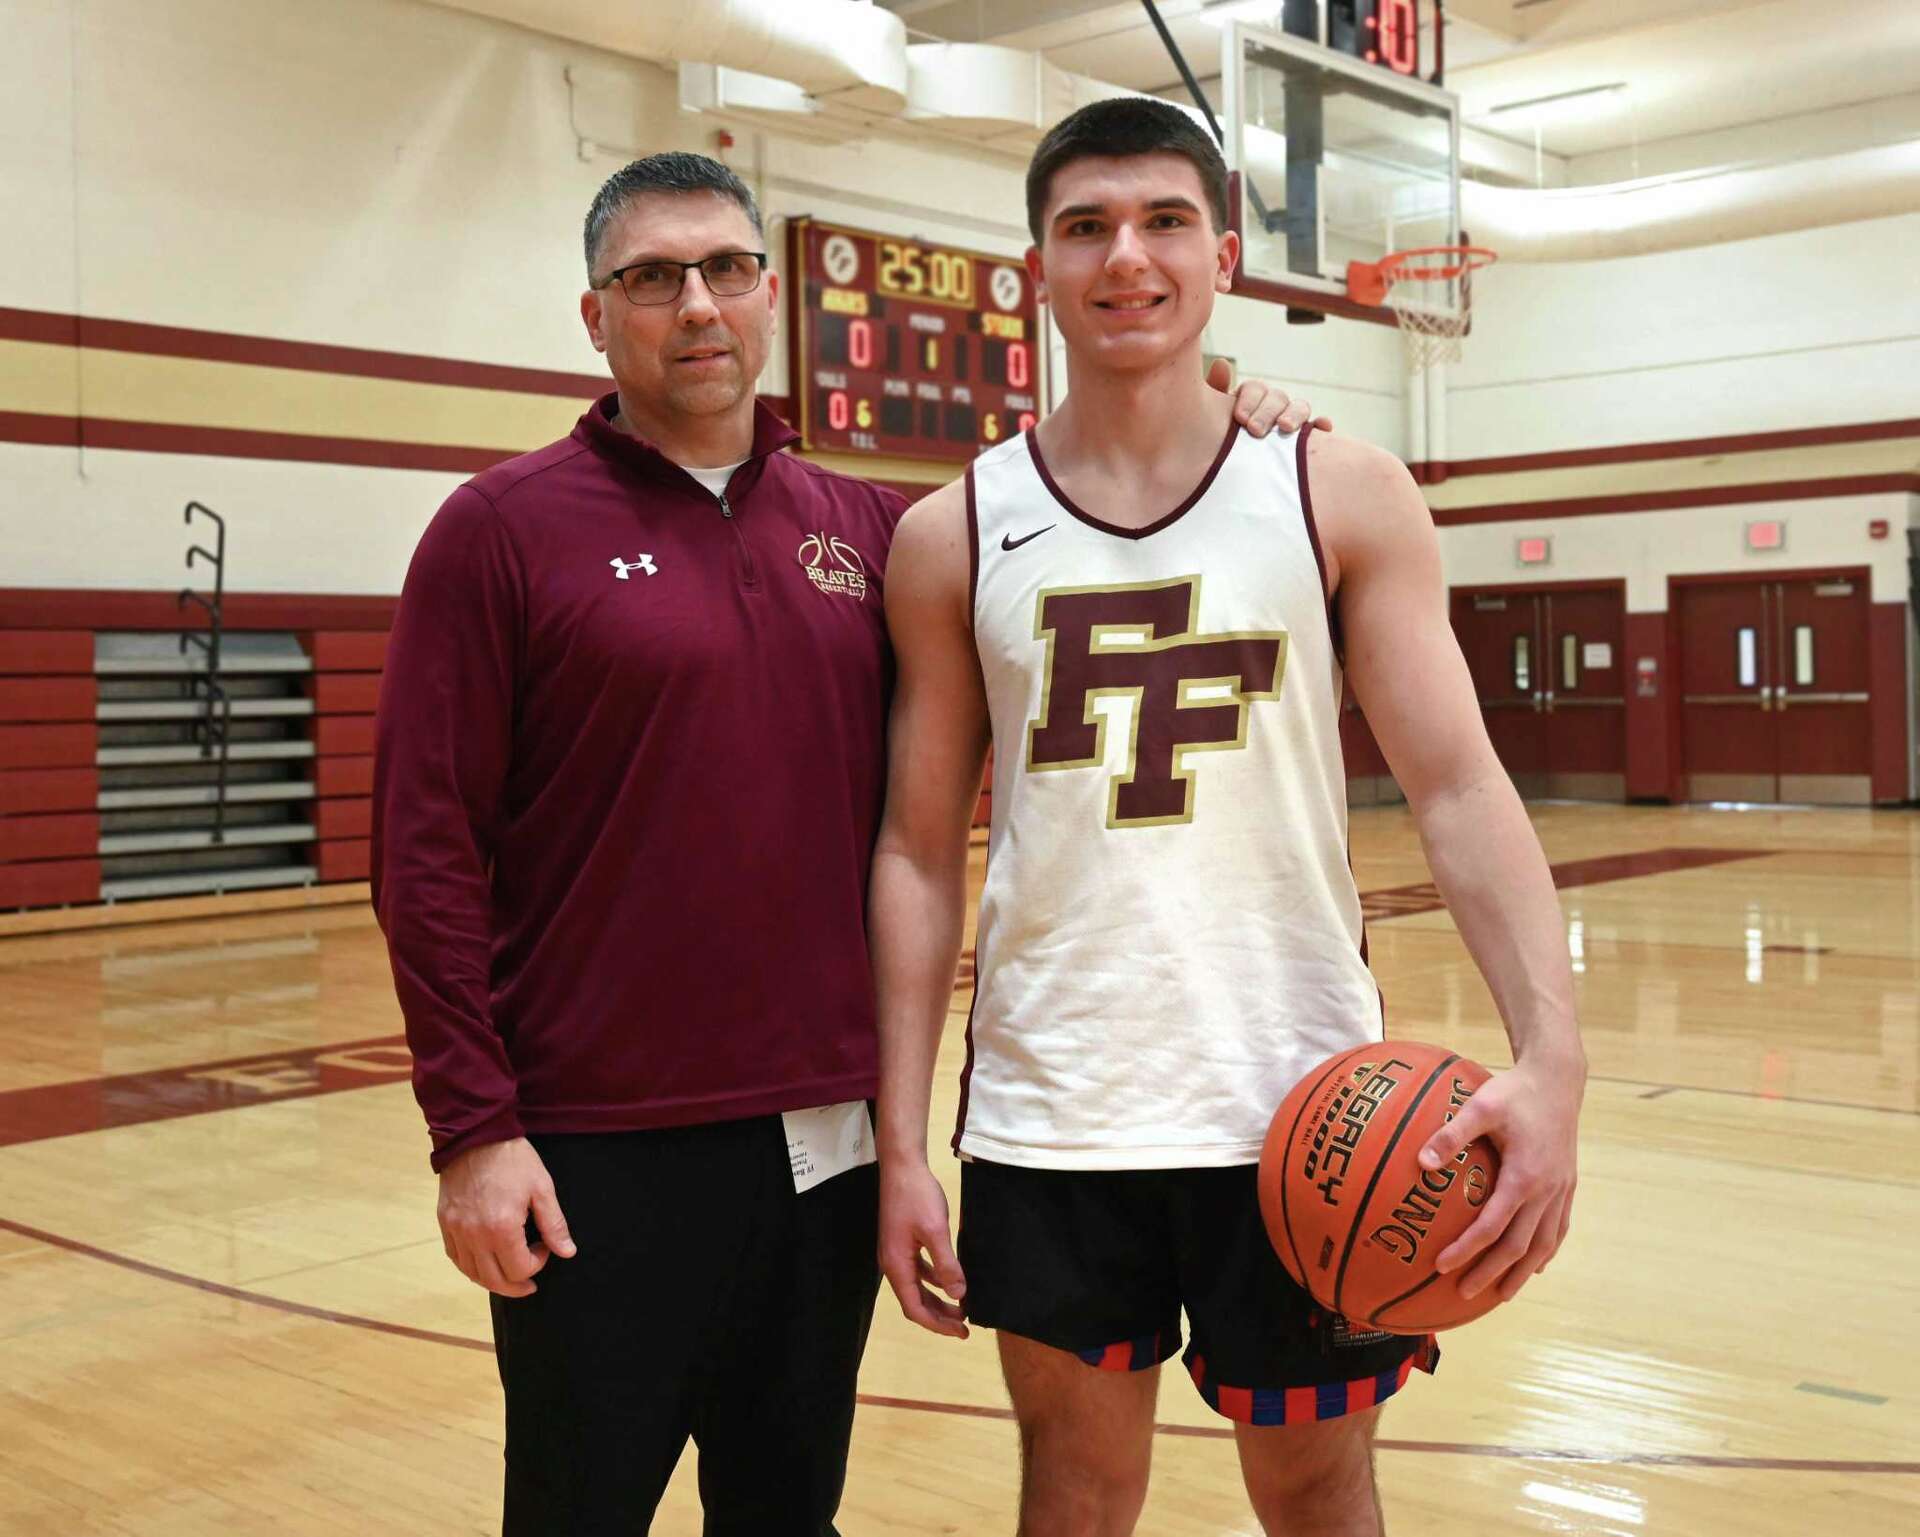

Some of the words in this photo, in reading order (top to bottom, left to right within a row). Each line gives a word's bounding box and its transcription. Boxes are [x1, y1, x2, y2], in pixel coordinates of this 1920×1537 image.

[881, 243, 969, 300] 25:00
[849, 319, 872, 368] 0
[926, 337, 938, 371] 1
[1007, 342, 1028, 388] 0
[828, 391, 848, 430] 0
[856, 399, 873, 428] 6
[984, 413, 999, 441] 6
[805, 566, 866, 589] BRAVES
[1026, 574, 1289, 830] FF
[1316, 1058, 1414, 1206] LEGACY
[1370, 1077, 1475, 1265] DING
